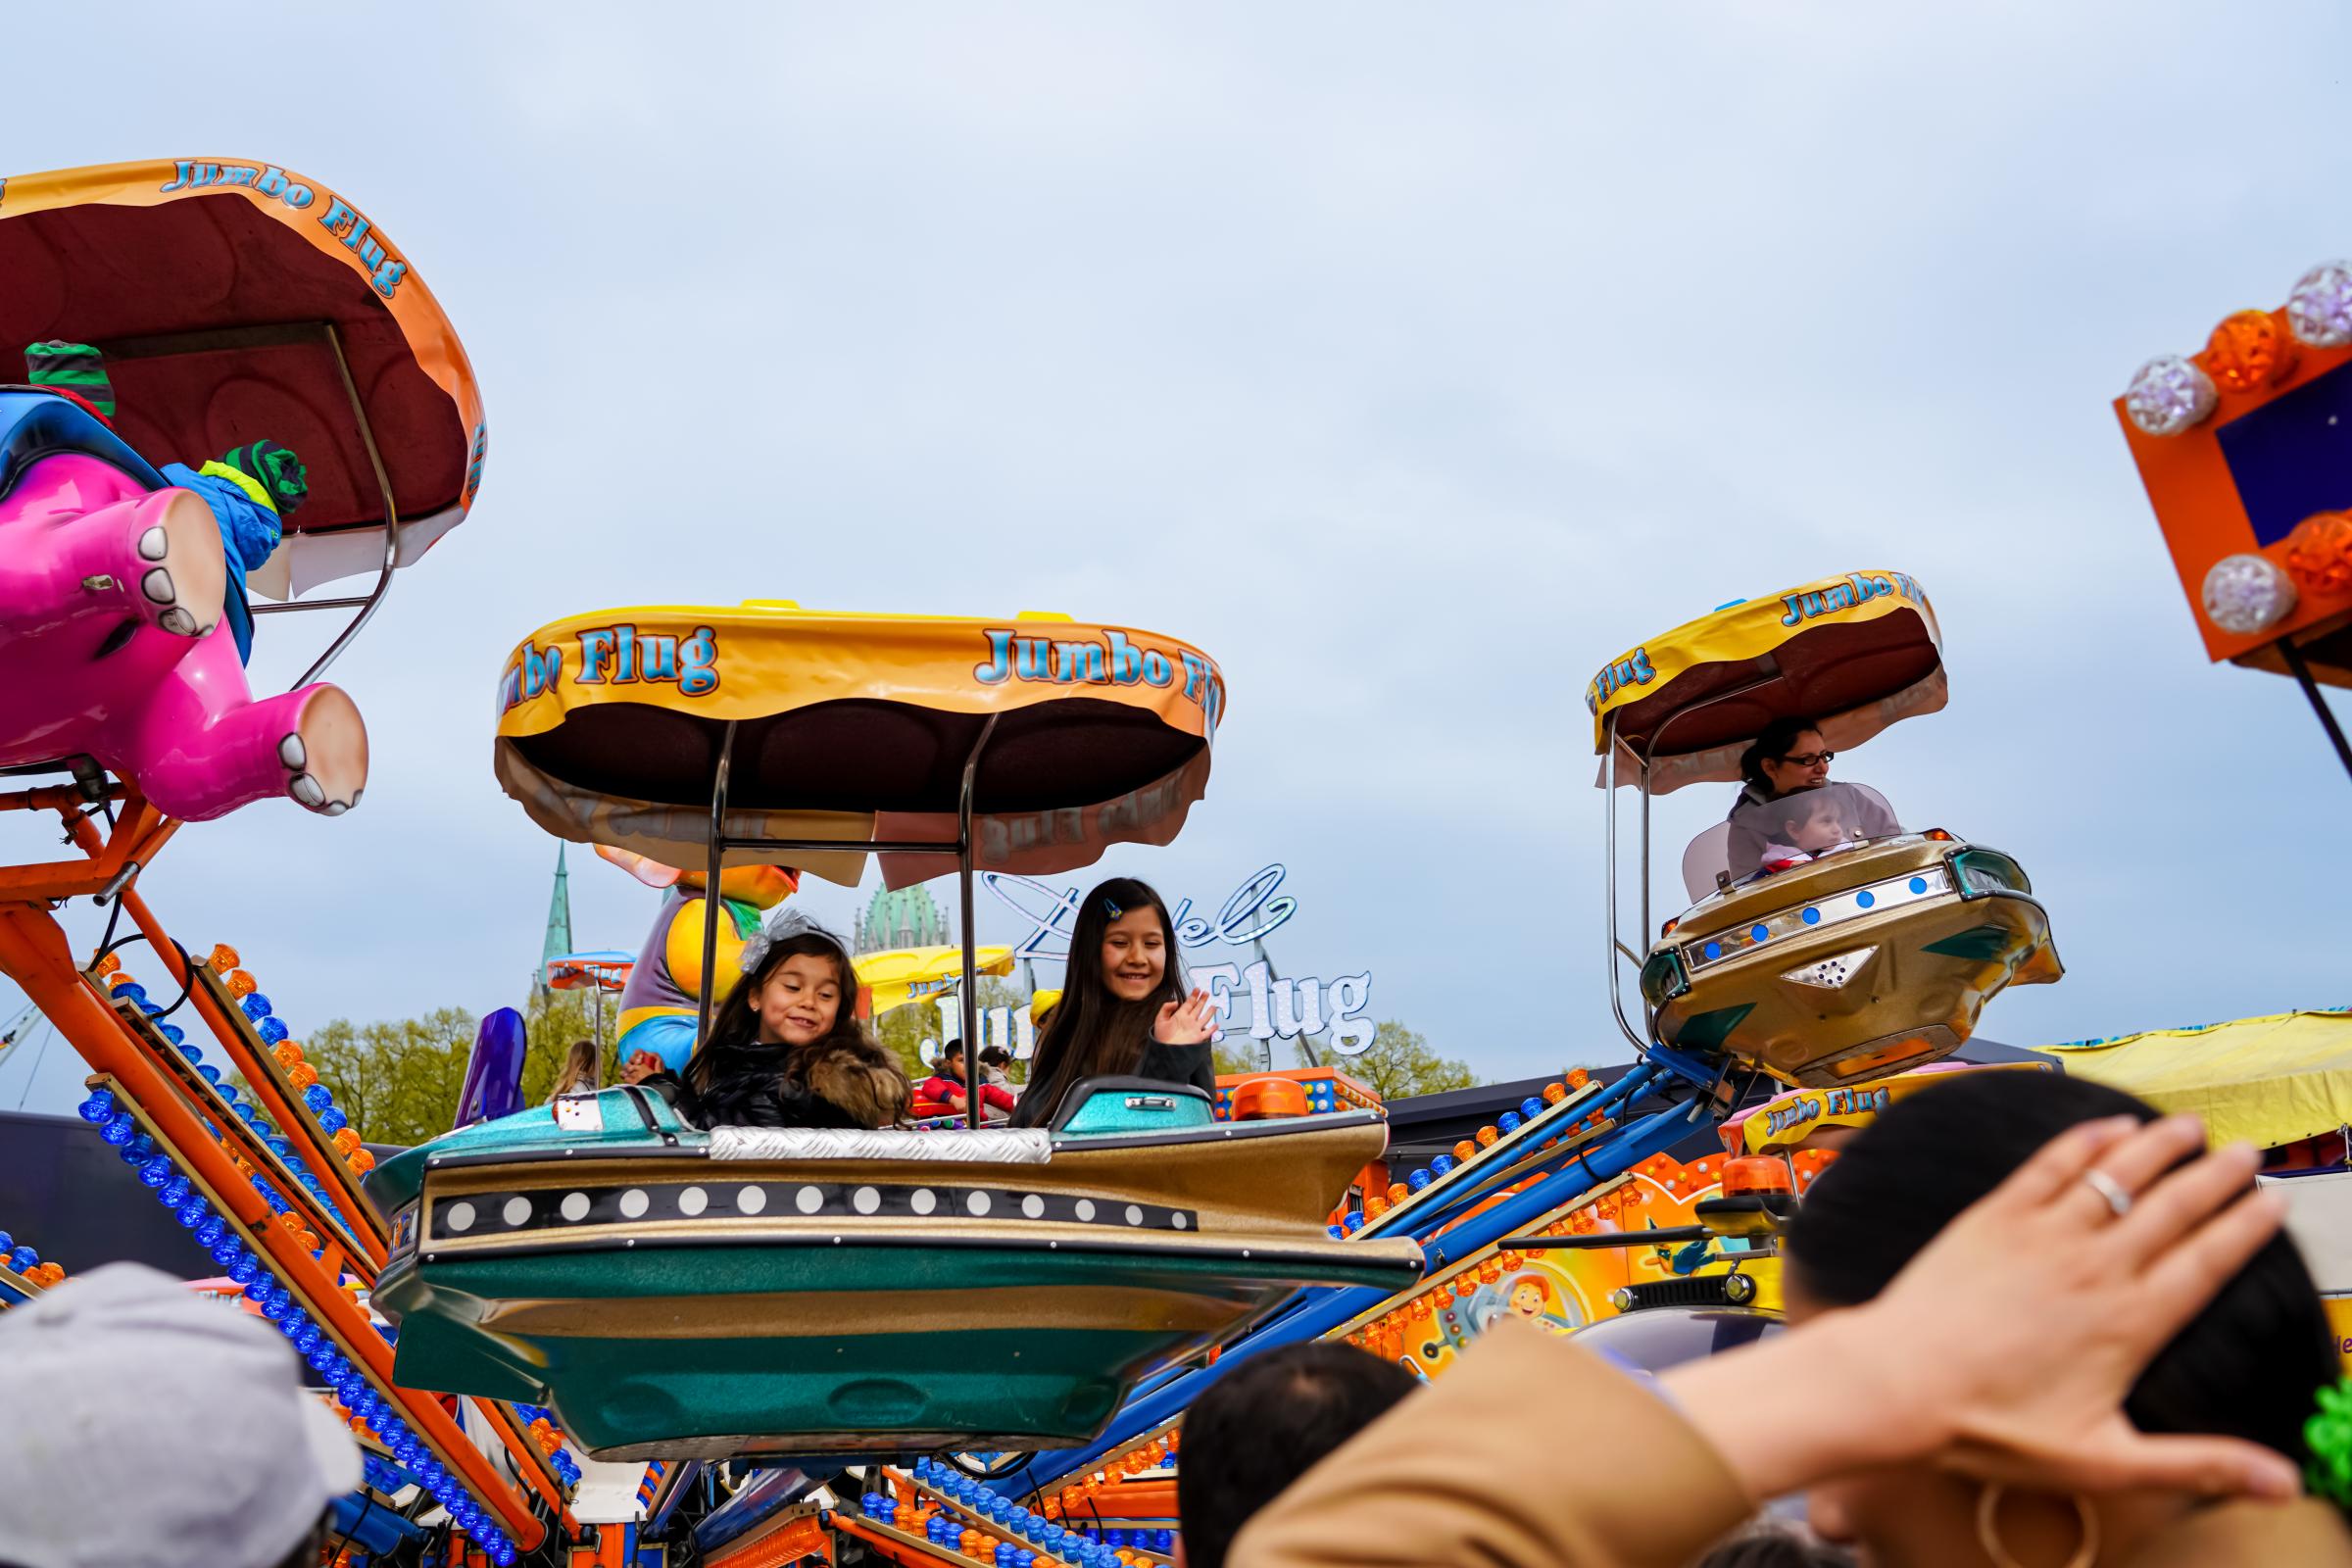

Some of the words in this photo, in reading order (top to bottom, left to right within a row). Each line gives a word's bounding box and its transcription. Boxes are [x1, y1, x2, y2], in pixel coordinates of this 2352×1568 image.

[160, 160, 315, 210] Jumbo
[319, 195, 408, 299] Flug
[1781, 572, 1894, 626] Jumbo
[574, 623, 720, 697] Flug
[973, 628, 1174, 687] Jumbo
[1594, 647, 1656, 705] Flug
[1189, 959, 1376, 1055] Flug
[1766, 1096, 1821, 1137] Jumbo
